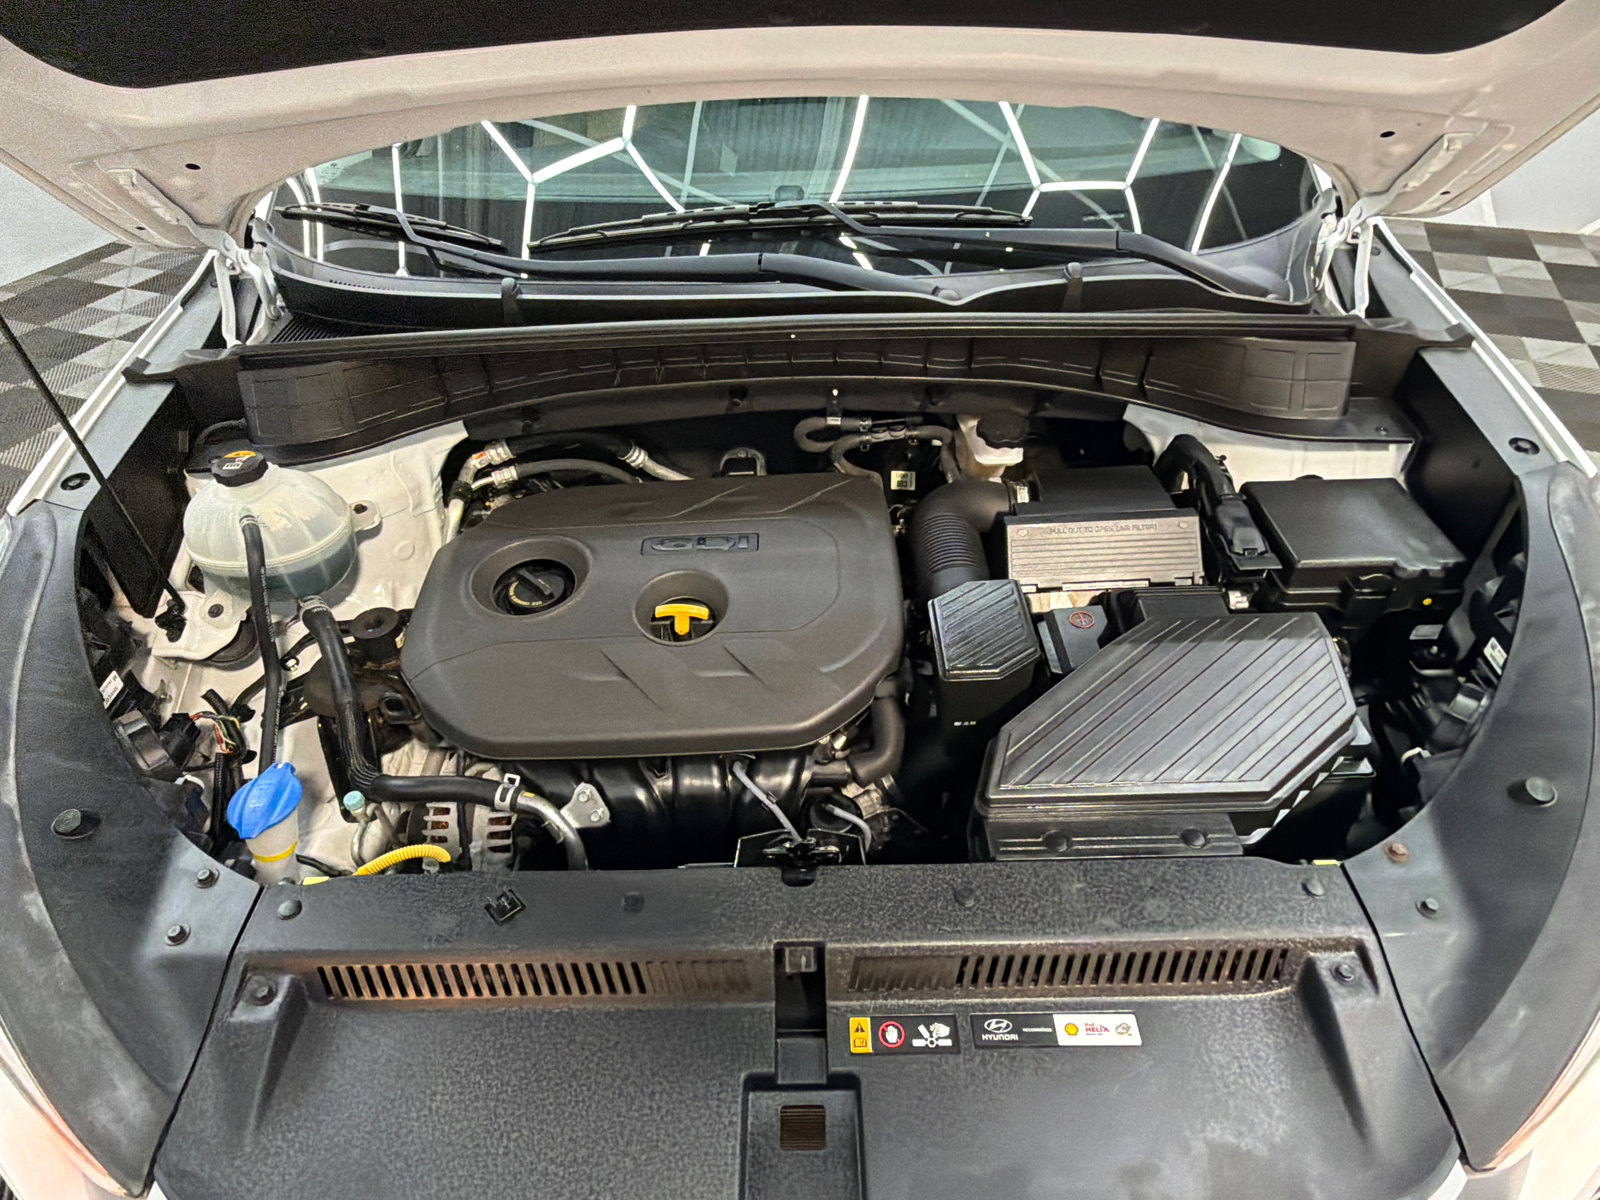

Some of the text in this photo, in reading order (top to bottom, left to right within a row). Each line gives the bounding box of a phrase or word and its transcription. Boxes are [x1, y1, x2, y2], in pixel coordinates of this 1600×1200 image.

[1049, 527, 1068, 535] PULL
[1068, 526, 1083, 534] OUT
[1095, 525, 1113, 533] OPEN
[982, 1033, 1019, 1041] HYUNDAI
